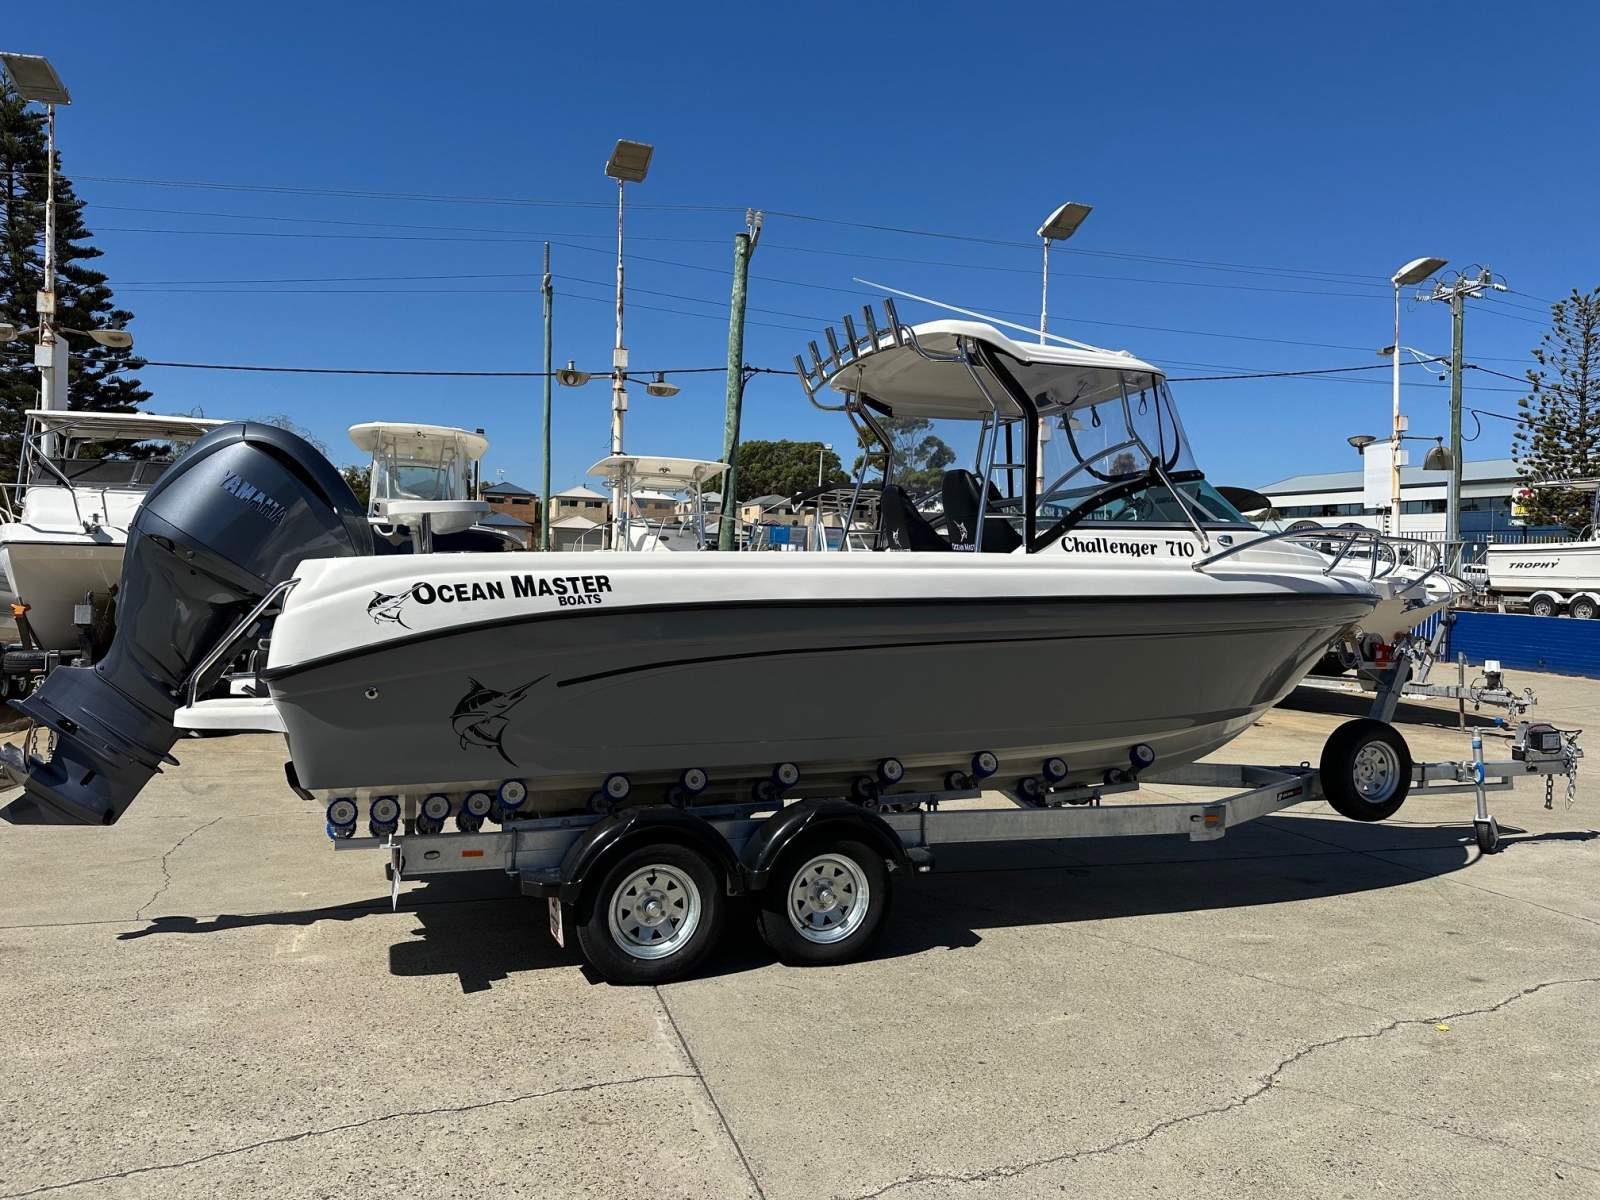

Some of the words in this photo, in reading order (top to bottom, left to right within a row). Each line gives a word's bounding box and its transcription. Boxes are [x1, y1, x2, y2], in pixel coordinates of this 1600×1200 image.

[220, 469, 288, 526] YAMAHA
[1061, 536, 1158, 557] Challenger
[1165, 540, 1194, 557] 710
[411, 581, 506, 605] OCEAN
[510, 574, 612, 598] MASTER
[558, 593, 602, 606] BOATS
